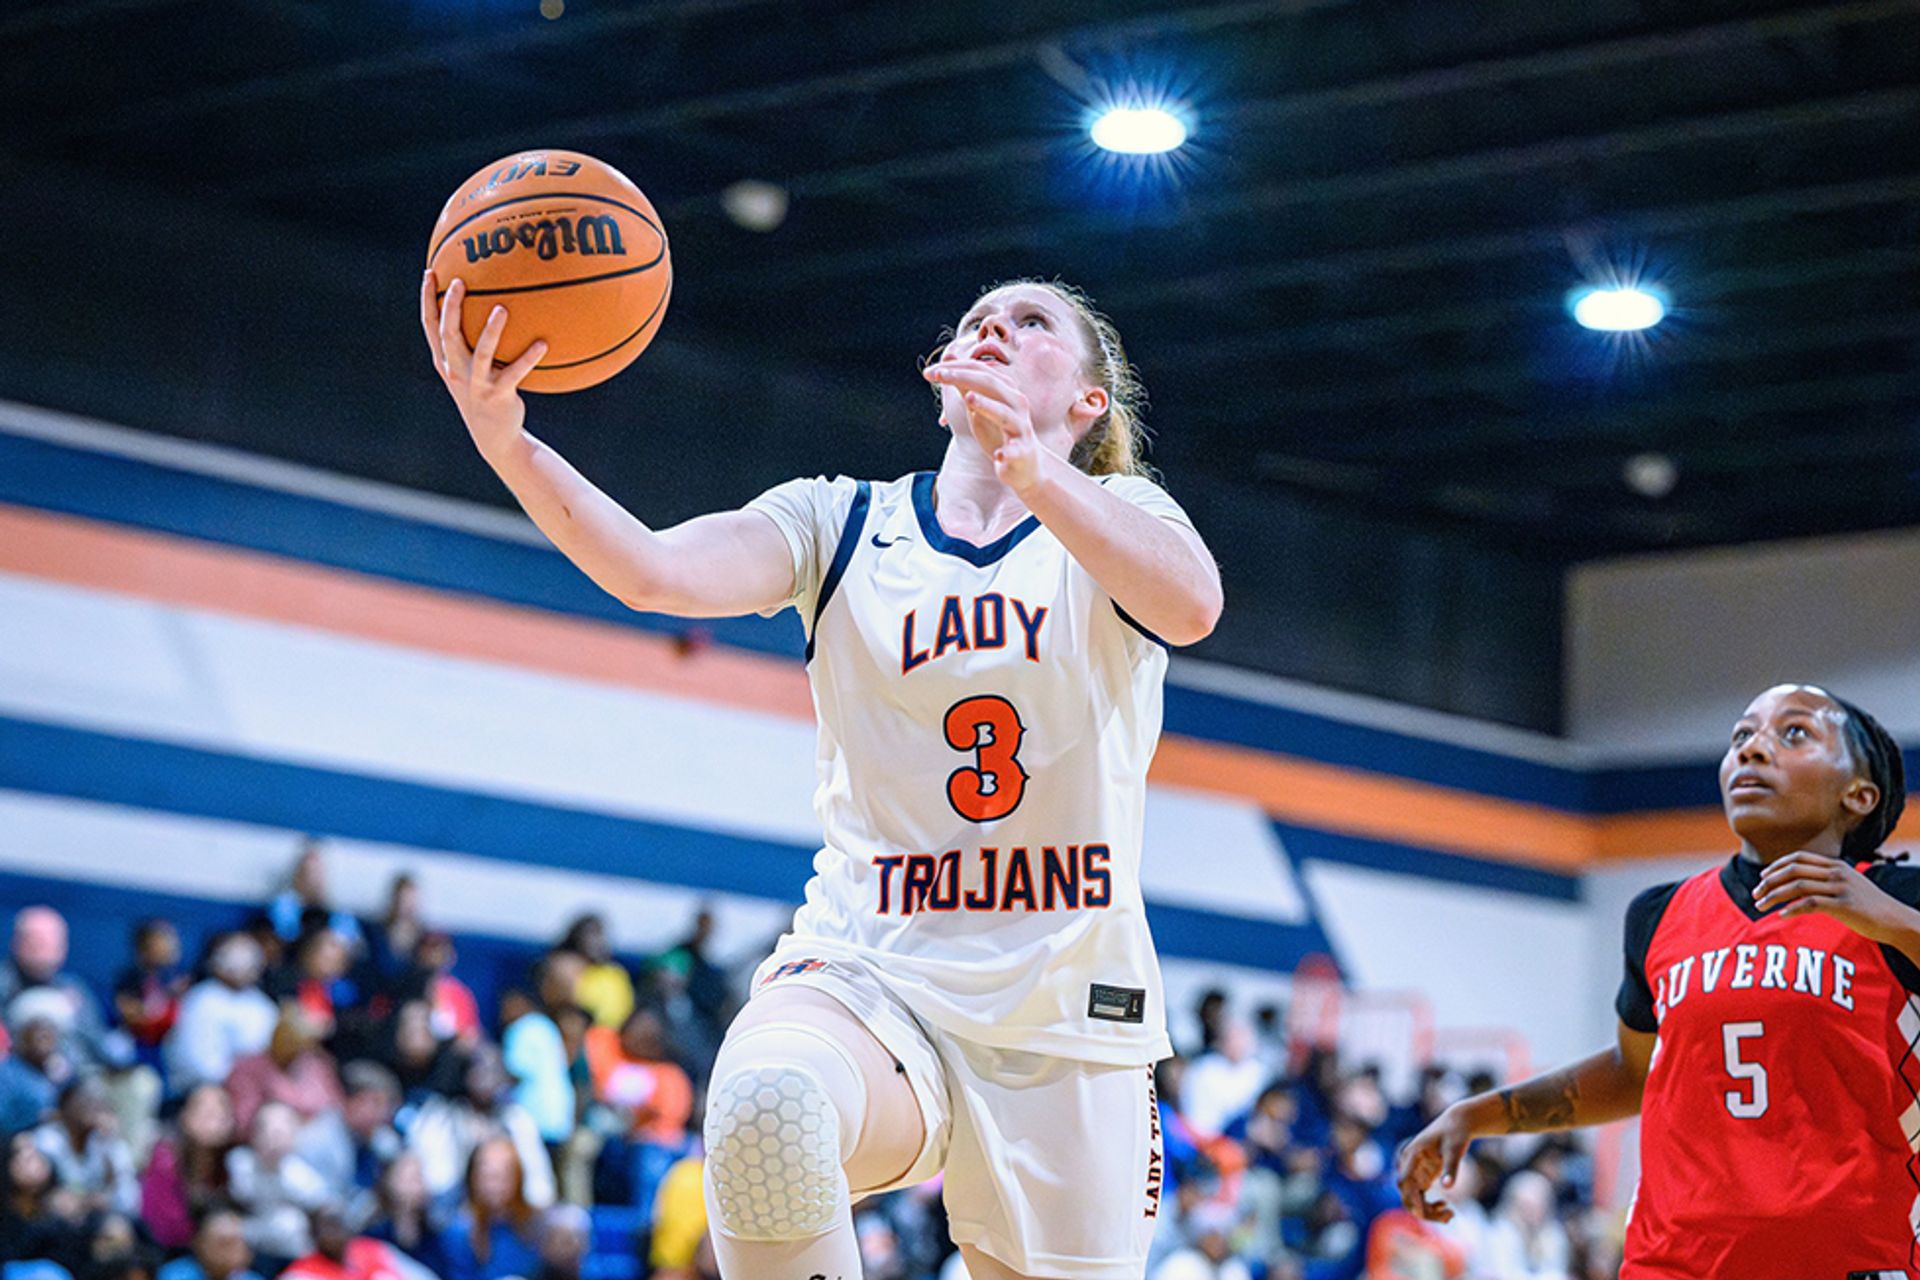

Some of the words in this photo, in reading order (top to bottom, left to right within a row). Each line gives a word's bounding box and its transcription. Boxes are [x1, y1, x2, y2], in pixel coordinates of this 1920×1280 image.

[485, 160, 582, 190] EVO
[462, 213, 627, 264] Wilson
[902, 592, 1048, 675] LADY
[943, 695, 1030, 823] 3
[872, 843, 1112, 915] TROJANS
[1721, 1021, 1769, 1119] 5
[1144, 1149, 1163, 1218] LADY
